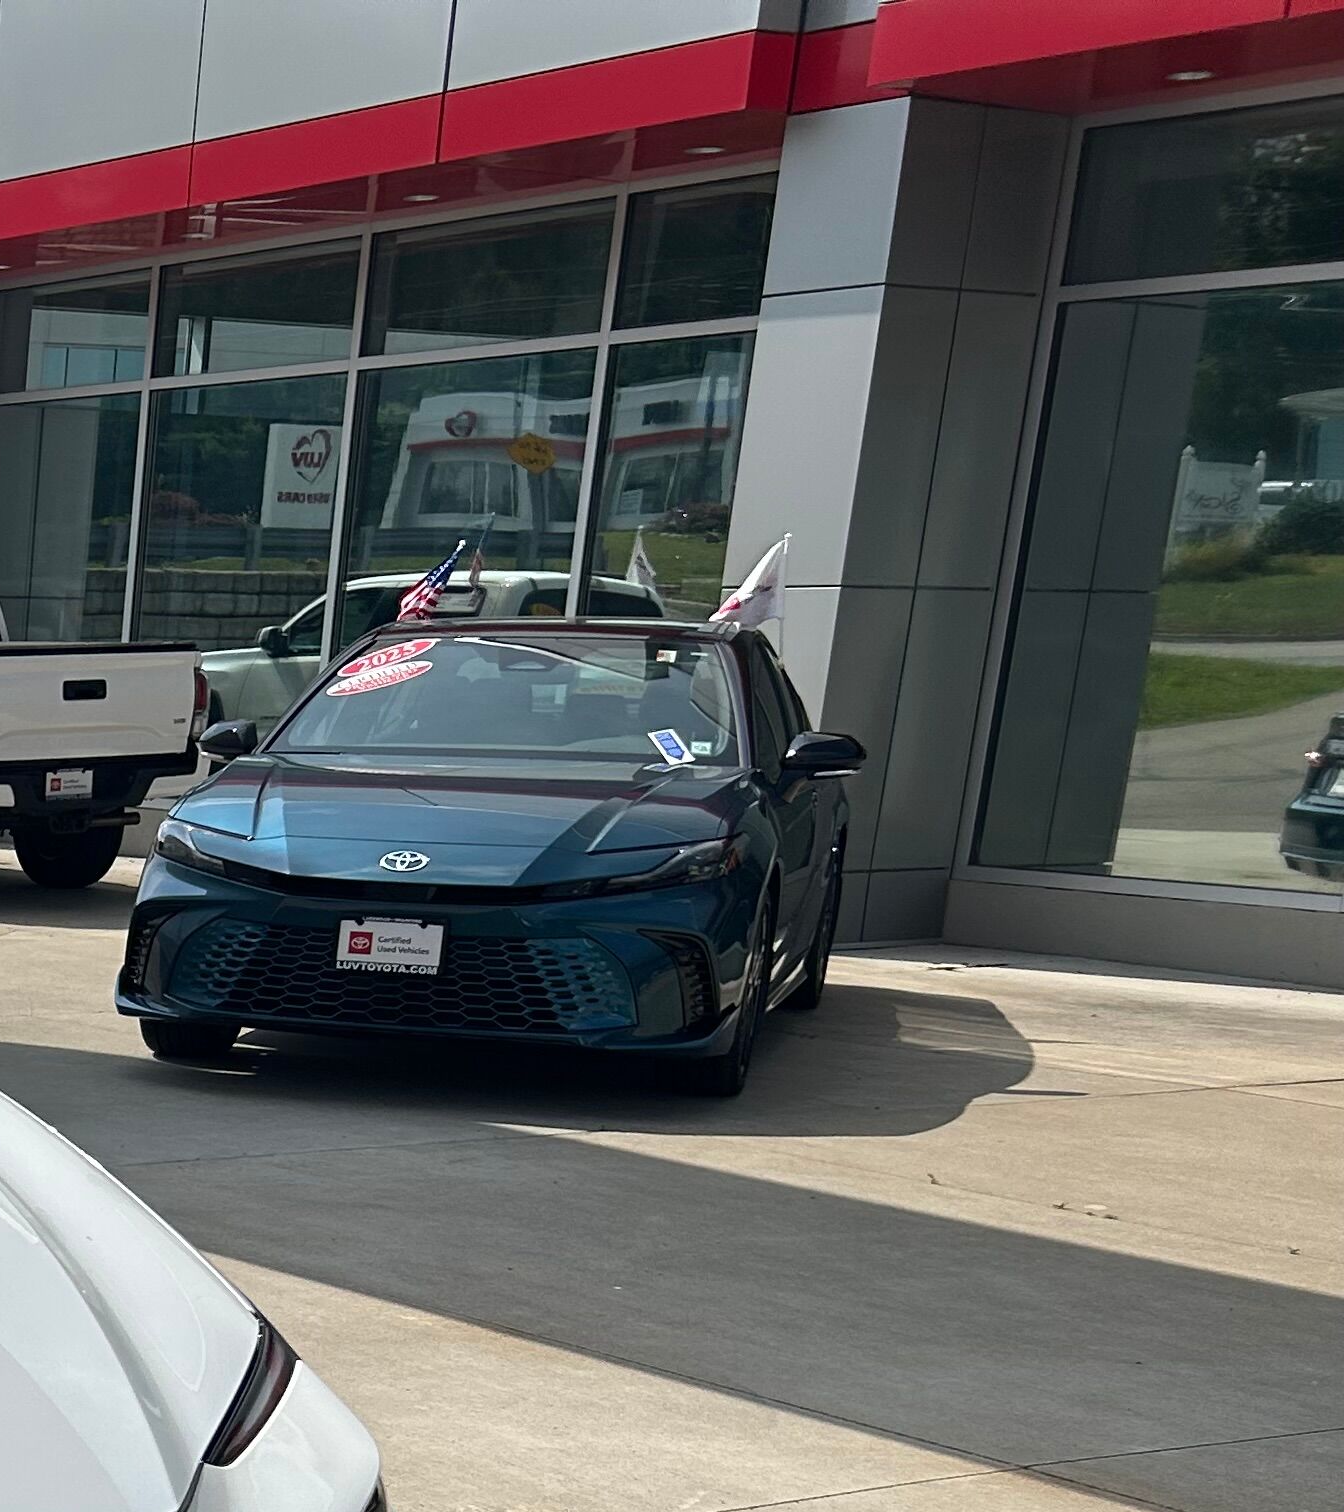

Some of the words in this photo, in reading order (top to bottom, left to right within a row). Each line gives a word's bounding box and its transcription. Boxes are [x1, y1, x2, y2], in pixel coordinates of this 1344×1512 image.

[357, 642, 416, 672] 2025
[377, 936, 412, 945] Certified
[377, 945, 397, 954] Used
[398, 946, 430, 956] Vehicles
[336, 960, 438, 976] LUVTOYOTA.COM
